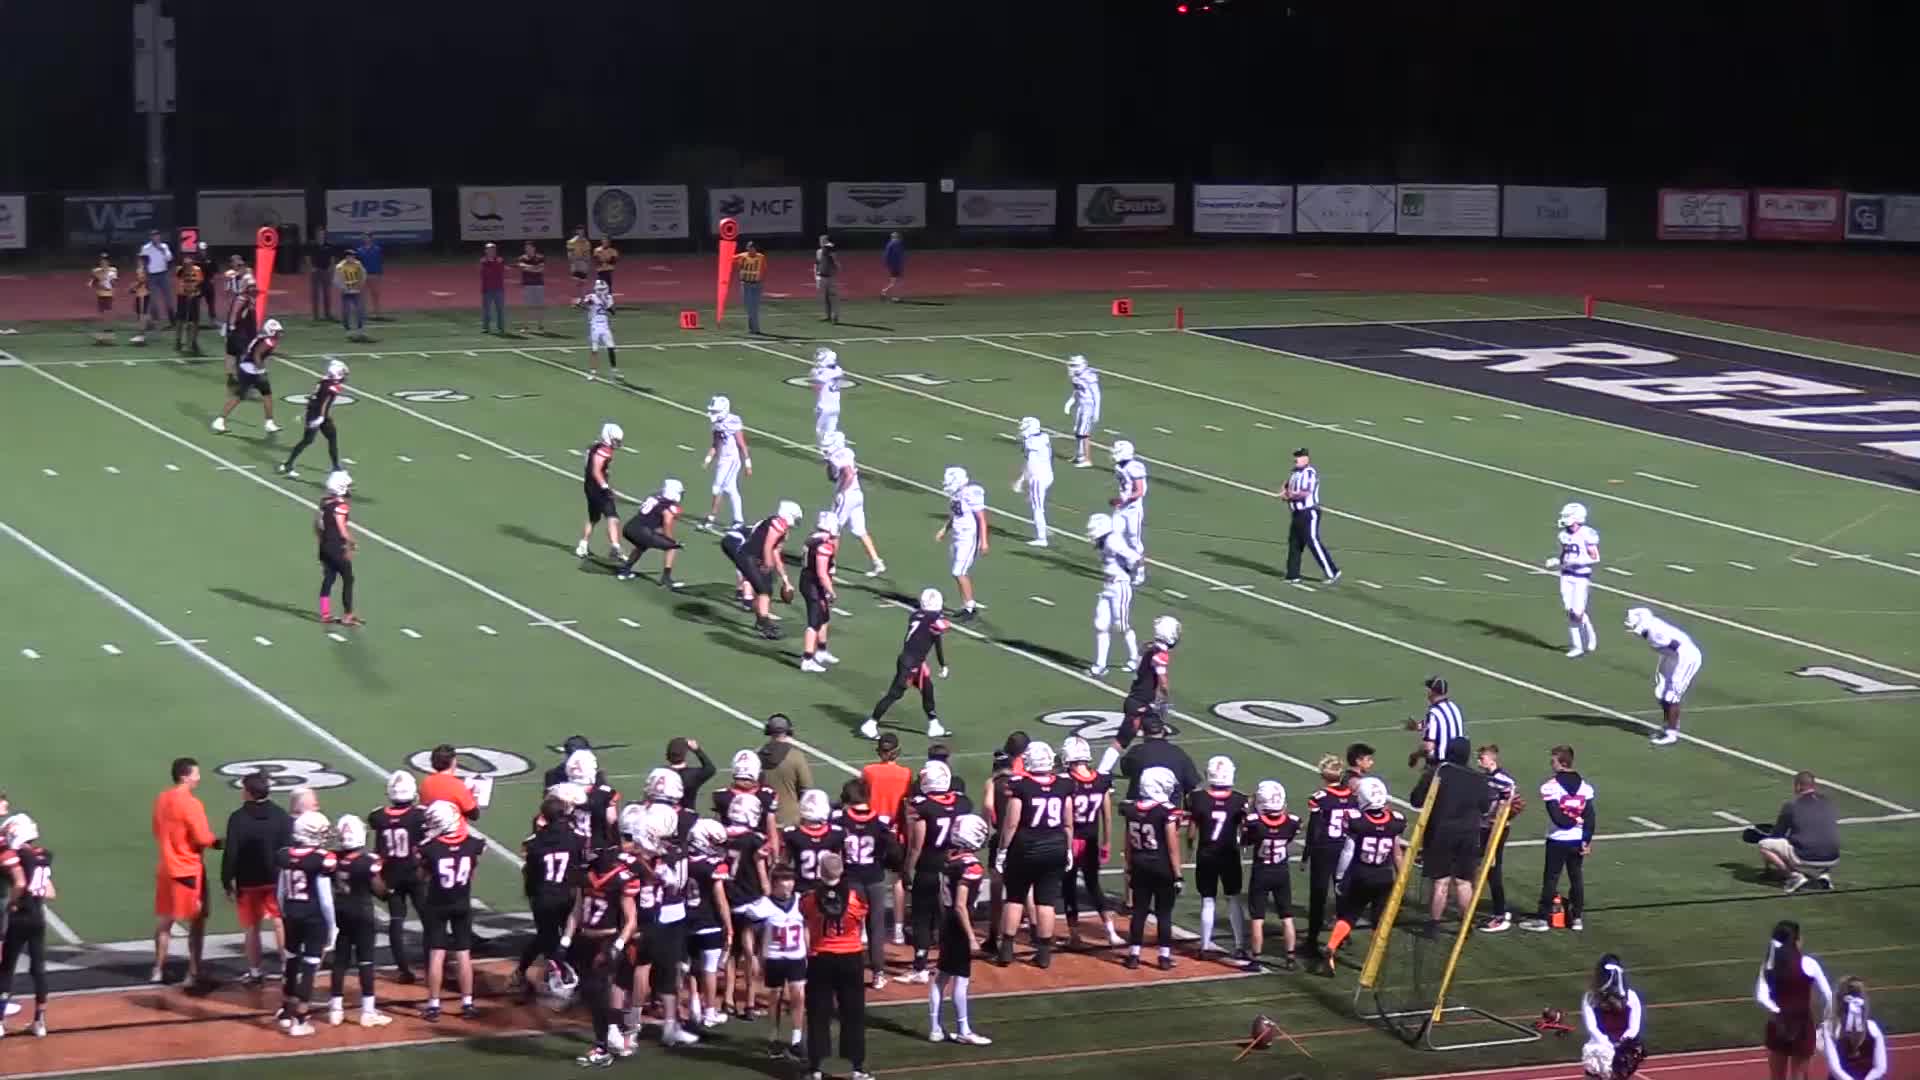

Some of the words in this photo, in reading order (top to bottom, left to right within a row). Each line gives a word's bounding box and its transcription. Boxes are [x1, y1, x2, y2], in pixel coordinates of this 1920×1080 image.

[351, 199, 402, 218] IPS
[750, 199, 793, 216] MCF
[684, 312, 697, 327] 10
[1117, 301, 1129, 314] G
[1030, 797, 1062, 828] 79
[1074, 793, 1103, 823] 27
[1128, 821, 1158, 850] 53
[1210, 811, 1227, 841] 7
[383, 828, 409, 858] 10
[1258, 839, 1289, 865] 45
[437, 856, 471, 888] 54
[543, 852, 570, 883] 17
